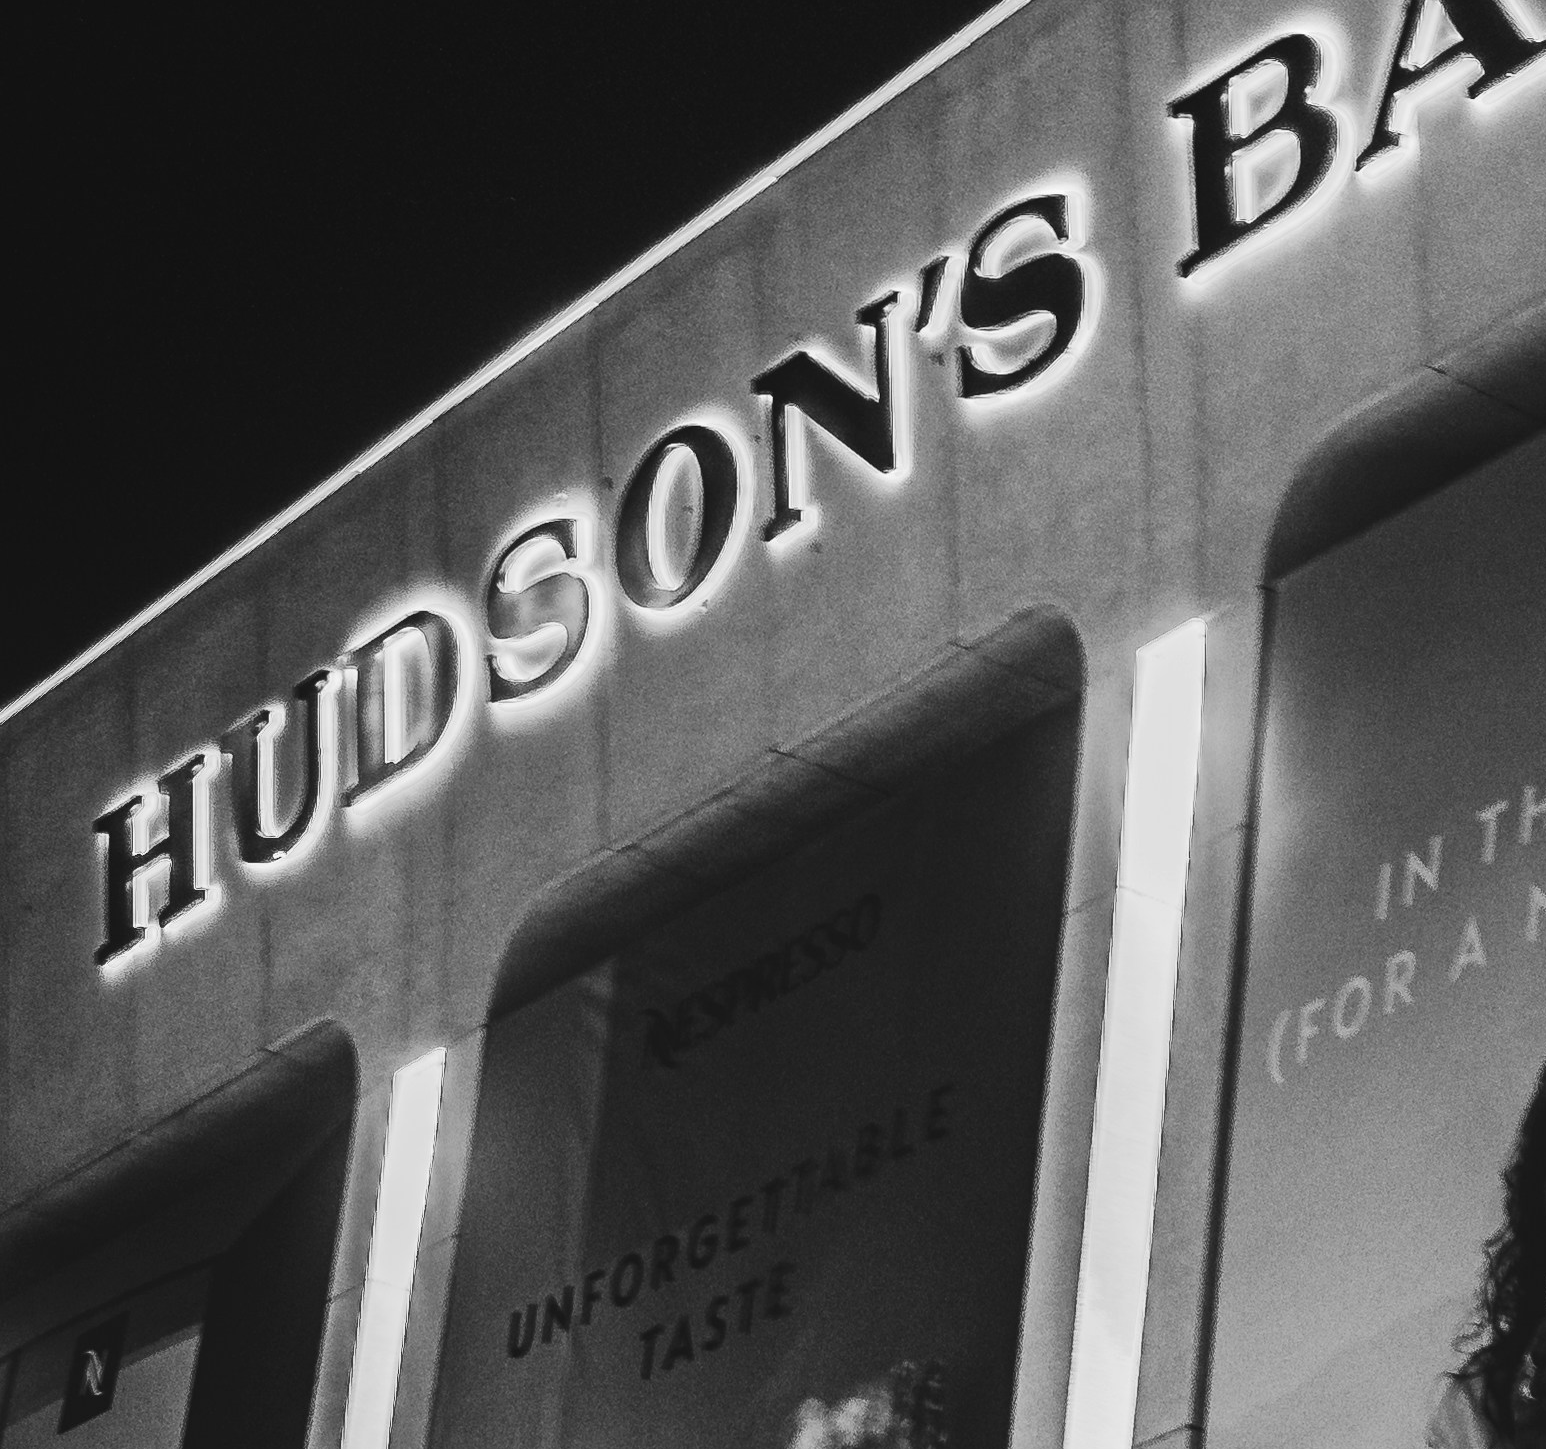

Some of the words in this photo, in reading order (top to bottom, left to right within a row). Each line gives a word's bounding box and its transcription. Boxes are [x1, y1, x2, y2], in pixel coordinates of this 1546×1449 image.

[93, 192, 1089, 969] HUDSON'S
[1373, 833, 1444, 922] IN
[638, 891, 884, 1071] NESPRESSO
[1265, 948, 1418, 1085] (FOR
[1449, 920, 1488, 984] A
[505, 1082, 956, 1360] UNFORGETTABLE
[638, 1260, 797, 1382] TASTE
